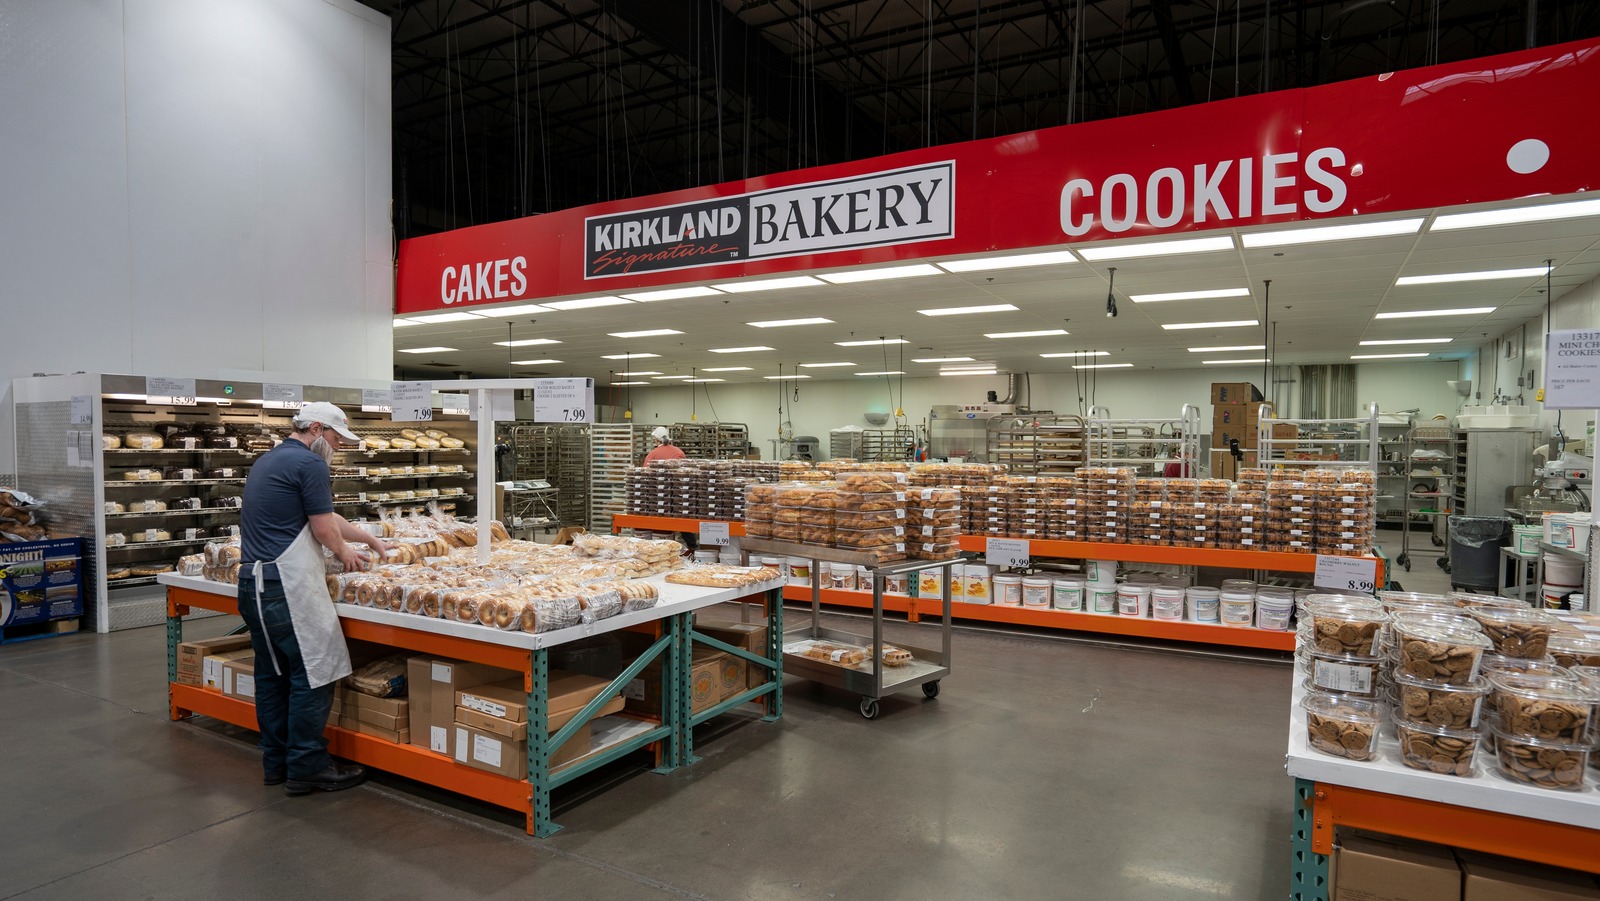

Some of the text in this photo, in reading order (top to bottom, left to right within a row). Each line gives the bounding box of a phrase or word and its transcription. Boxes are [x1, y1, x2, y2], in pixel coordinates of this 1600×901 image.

[1060, 147, 1347, 236] COOKIES
[594, 178, 942, 252] KIRKLAND BAKERY
[593, 243, 739, 274] Signature
[441, 256, 528, 305] CAKES
[170, 396, 196, 404] 15.99
[414, 409, 431, 420] 7.99
[563, 409, 585, 421] 7.99
[1011, 558, 1029, 566] 9.99
[1348, 580, 1373, 590] 8.99
